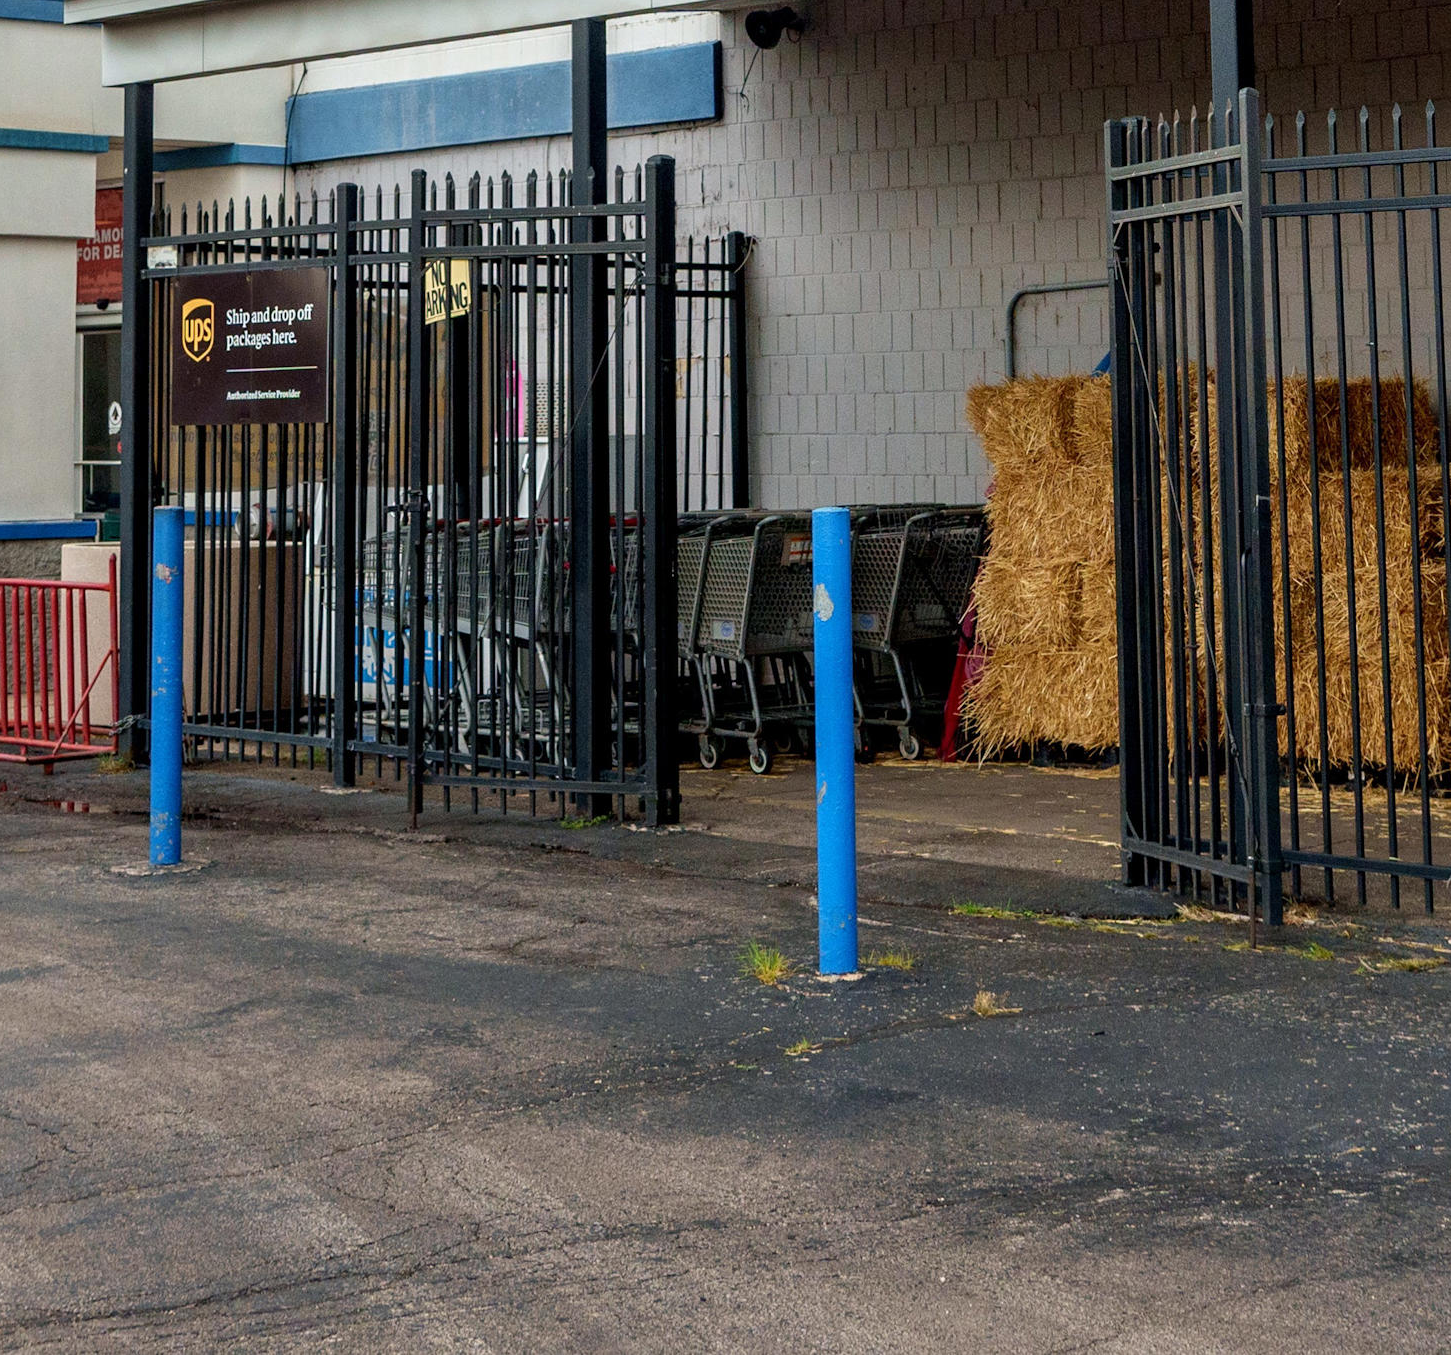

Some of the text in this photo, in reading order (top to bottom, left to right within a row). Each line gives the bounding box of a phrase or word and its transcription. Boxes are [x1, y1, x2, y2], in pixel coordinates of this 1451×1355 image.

[86, 227, 123, 245] AMO
[104, 244, 123, 259] DE
[426, 282, 468, 319] ARKNG
[226, 303, 314, 328] Ship and drop off
[185, 317, 212, 352] ups
[226, 328, 297, 351] packages here.
[226, 389, 301, 401] Authorized Service Provider
